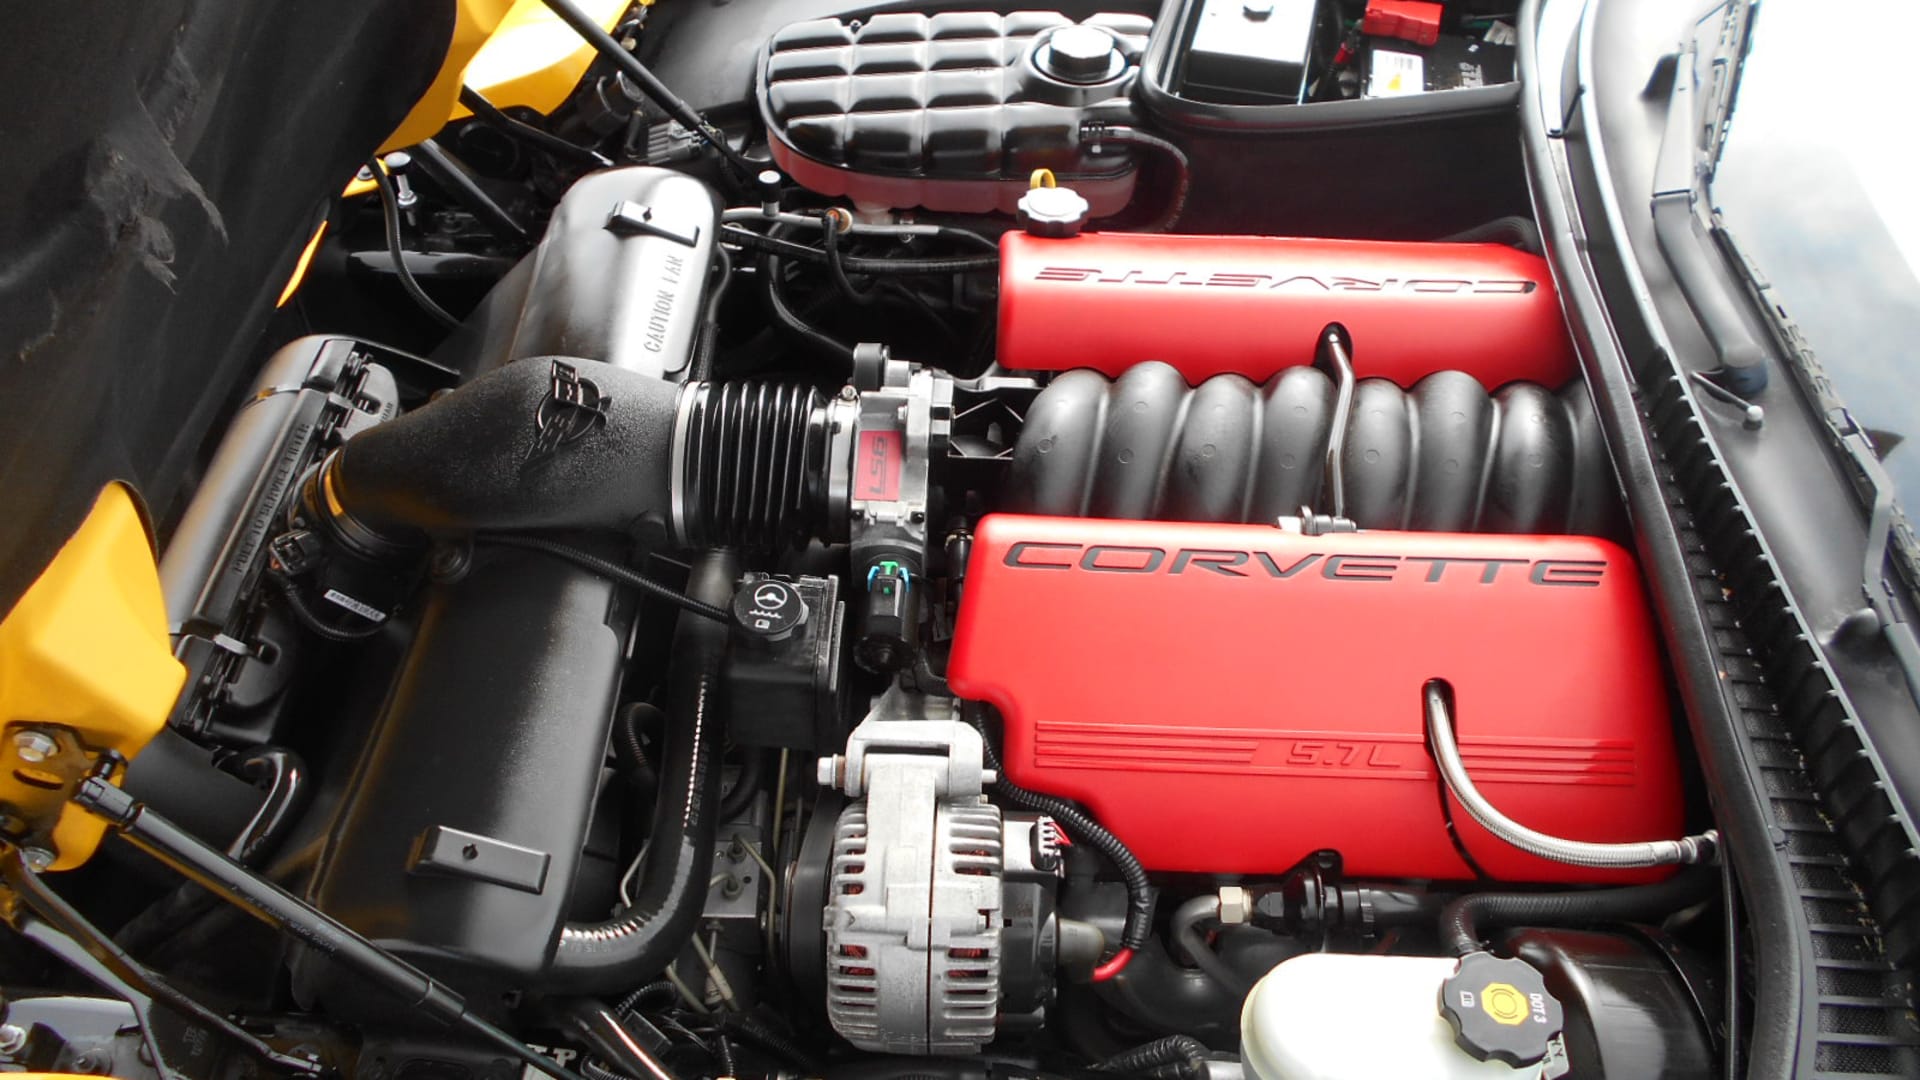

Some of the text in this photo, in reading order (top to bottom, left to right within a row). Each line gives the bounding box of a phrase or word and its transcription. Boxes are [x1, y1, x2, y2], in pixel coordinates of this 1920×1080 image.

[1034, 266, 1538, 293] CORVETTE
[643, 289, 674, 352] CAUTION
[869, 436, 887, 496] LS6
[250, 518, 265, 536] TO
[260, 467, 289, 516] SERVICE
[1002, 540, 1608, 587] CORVETTE
[1286, 742, 1401, 768] 5.7L
[1530, 993, 1547, 1024] DOT 3
